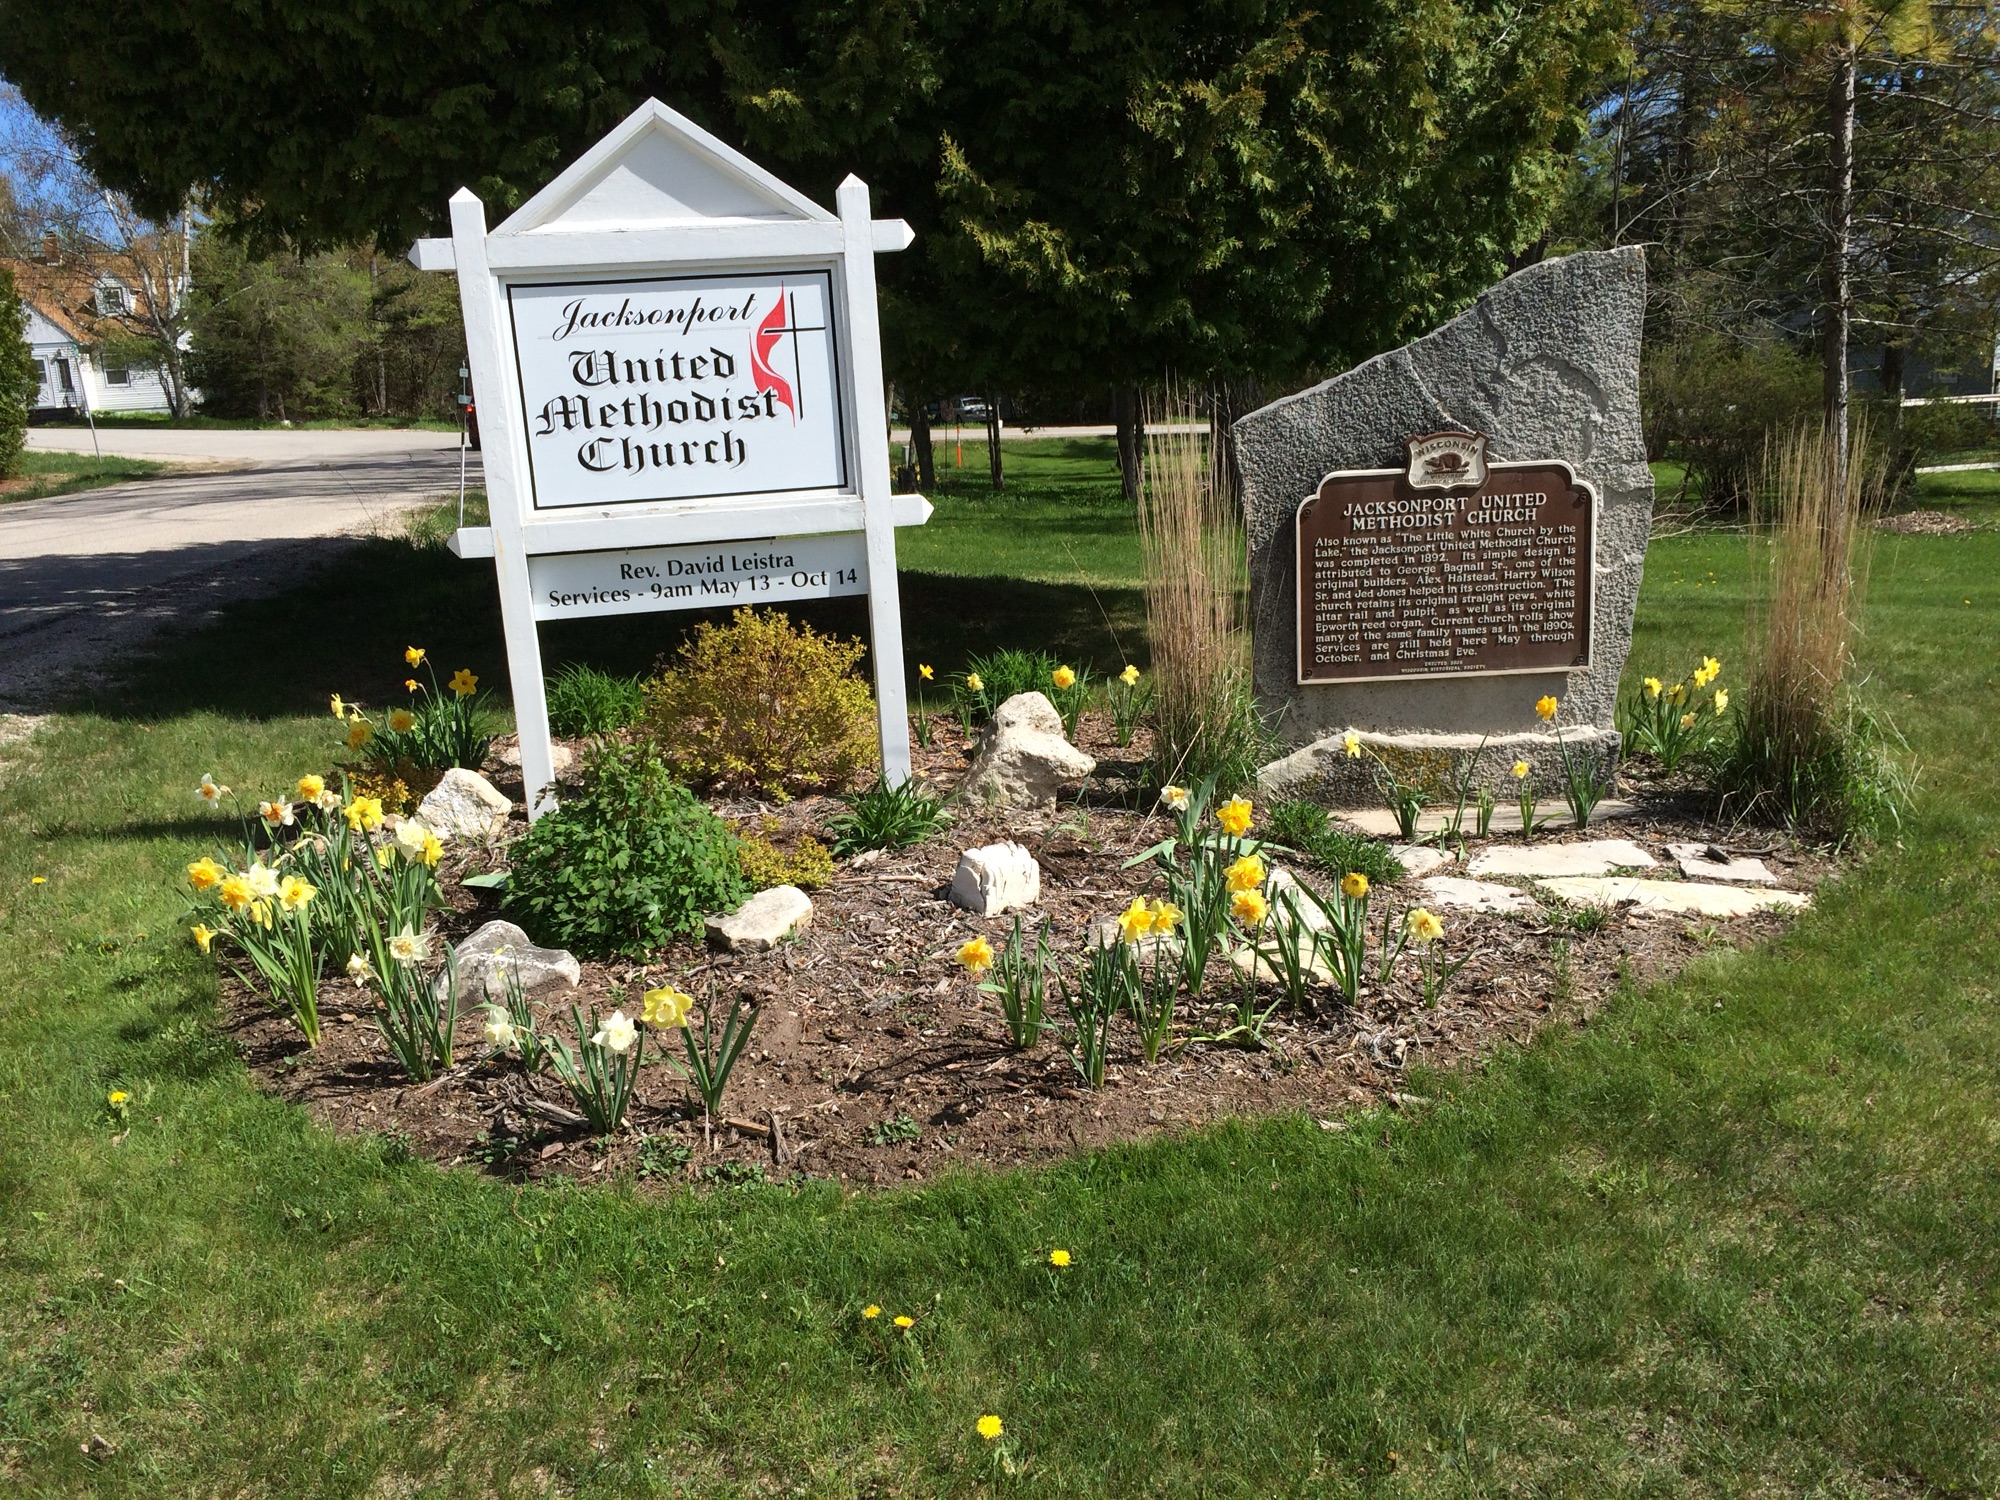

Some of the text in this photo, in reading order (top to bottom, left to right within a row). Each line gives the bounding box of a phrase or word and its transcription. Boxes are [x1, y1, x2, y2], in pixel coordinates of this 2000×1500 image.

[552, 293, 759, 341] Jacksonport
[568, 347, 737, 386] United
[536, 388, 778, 437] Methodist
[578, 430, 746, 476] Church
[1415, 440, 1479, 457] WISCONSIN
[1343, 492, 1547, 516] JACKSONPORT UNITED
[1352, 507, 1537, 530] METHODIST CHURCH
[1315, 537, 1339, 546] Also
[1342, 536, 1376, 545] known
[1380, 535, 1392, 543] as
[1426, 531, 1454, 541] Little
[1460, 528, 1490, 538] White
[1496, 526, 1535, 536] Church
[1539, 525, 1553, 535] by
[1558, 524, 1576, 533] the
[1350, 546, 1368, 555] the
[1371, 543, 1435, 554] Jacksonport
[1440, 540, 1475, 550] United
[1479, 537, 1531, 548] Methodist
[1535, 534, 1576, 544] Church
[620, 552, 794, 580] Rev. David Leistra
[1315, 556, 1575, 578] attributed to George Bagnall Sr., one of the
[1340, 555, 1398, 567] completed
[1404, 553, 1415, 563] in
[1420, 552, 1448, 562] 1892.
[1462, 551, 1475, 560] Its
[1482, 549, 1517, 560] simple
[1524, 546, 1560, 557] design
[1567, 545, 1576, 554] is
[549, 586, 630, 607] Services
[651, 582, 693, 599] 9am
[701, 578, 740, 598] May
[749, 575, 770, 592] 13
[791, 571, 827, 588] Oct
[836, 568, 857, 585] 14
[1315, 567, 1575, 590] original builders. Alex Halstead, Harry Wilson
[1315, 578, 1575, 600] Sr. and Jed Jones helped in its construction. The
[1315, 589, 1575, 610] church retains its original straight pews, white
[1315, 612, 1342, 621] altar
[1349, 610, 1368, 619] rail
[1375, 608, 1394, 618] and
[1403, 606, 1437, 618] pulpit,
[1466, 604, 1488, 613] well
[1494, 604, 1506, 612] as
[1511, 602, 1524, 611] its
[1530, 599, 1574, 611] original
[1315, 610, 1574, 632] Epworth reed organ. Current church rolls show
[1315, 634, 1344, 642] many
[1348, 631, 1359, 640] of
[1363, 631, 1381, 639] the
[1386, 630, 1411, 638] same
[1416, 627, 1450, 637] family
[1454, 626, 1486, 635] names
[1508, 623, 1518, 632] in
[1522, 622, 1539, 631] the
[1543, 620, 1574, 630] 1890s.
[1315, 631, 1574, 652] Services are still held here May through
[1315, 647, 1477, 662] October, and Christmas Eve.
